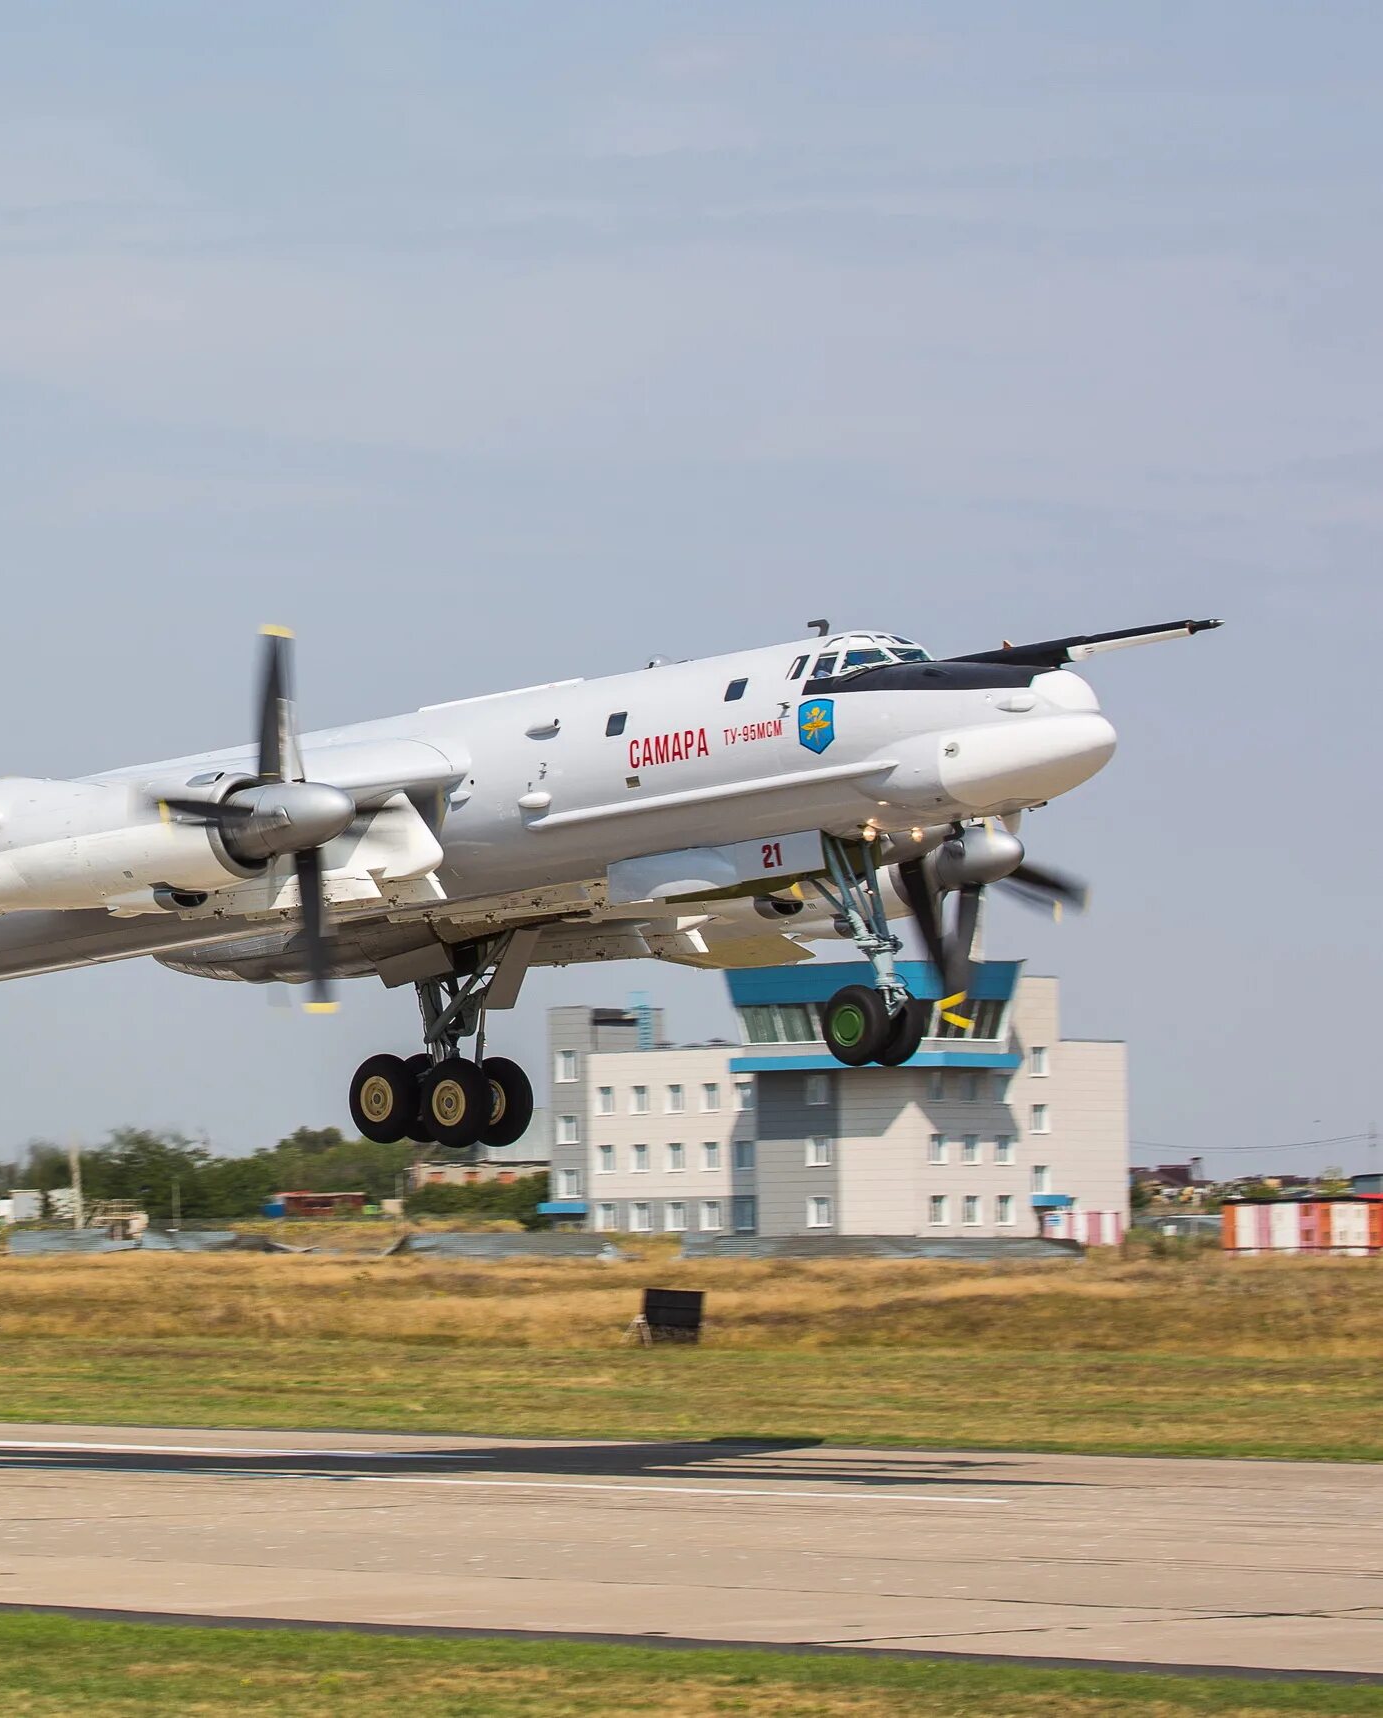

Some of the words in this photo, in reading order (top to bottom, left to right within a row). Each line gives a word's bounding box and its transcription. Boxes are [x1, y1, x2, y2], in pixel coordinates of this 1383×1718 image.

[629, 727, 710, 769] САМАРА
[723, 719, 783, 746] ТУ-95МСМ
[761, 842, 783, 869] 21
